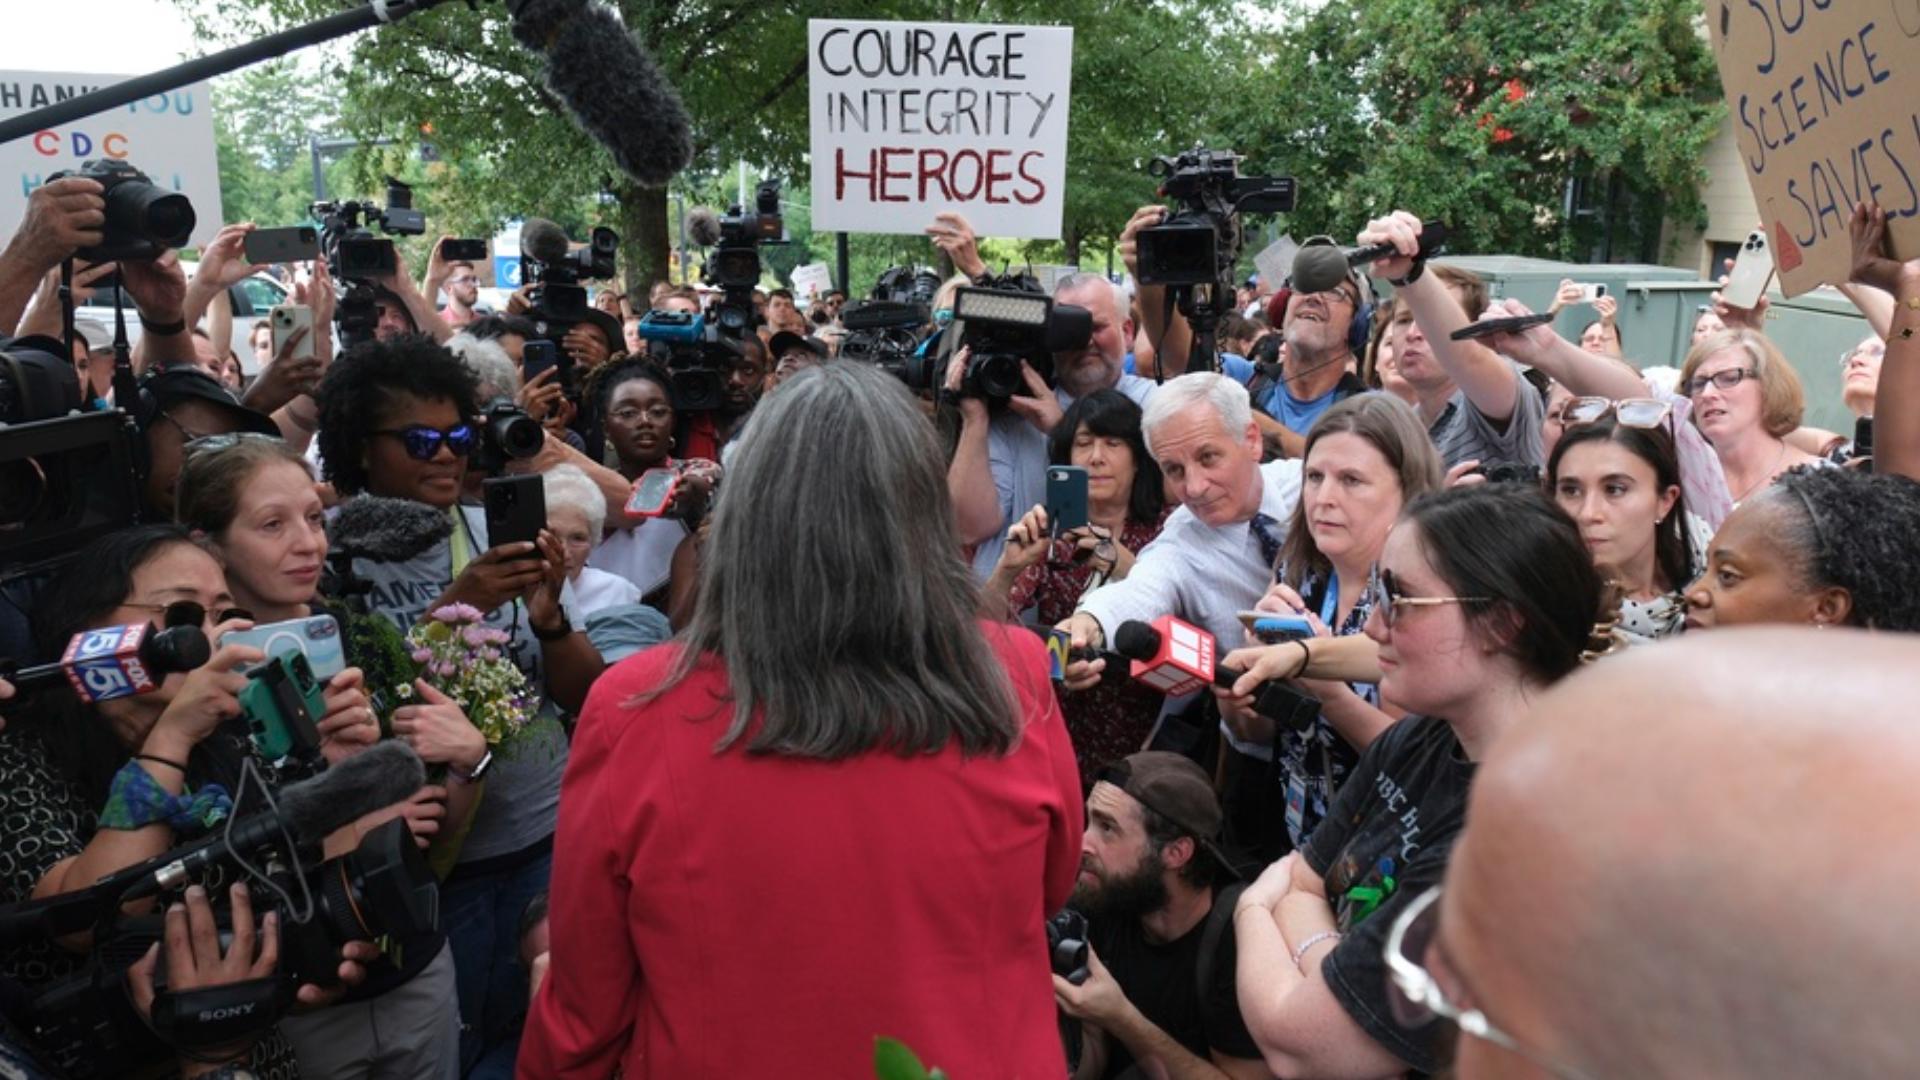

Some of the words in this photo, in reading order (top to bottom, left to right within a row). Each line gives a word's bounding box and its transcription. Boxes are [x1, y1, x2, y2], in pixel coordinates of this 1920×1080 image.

[818, 28, 1026, 80] COURAGE
[828, 87, 1055, 139] INTEGRITY
[1740, 22, 1890, 174] SCIENCE
[33, 129, 129, 159] CDC
[835, 146, 1046, 205] HEROES
[1788, 129, 1918, 247] SAVES
[85, 666, 128, 696] 5
[121, 657, 153, 690] FOX
[199, 1001, 256, 1022] SONY
